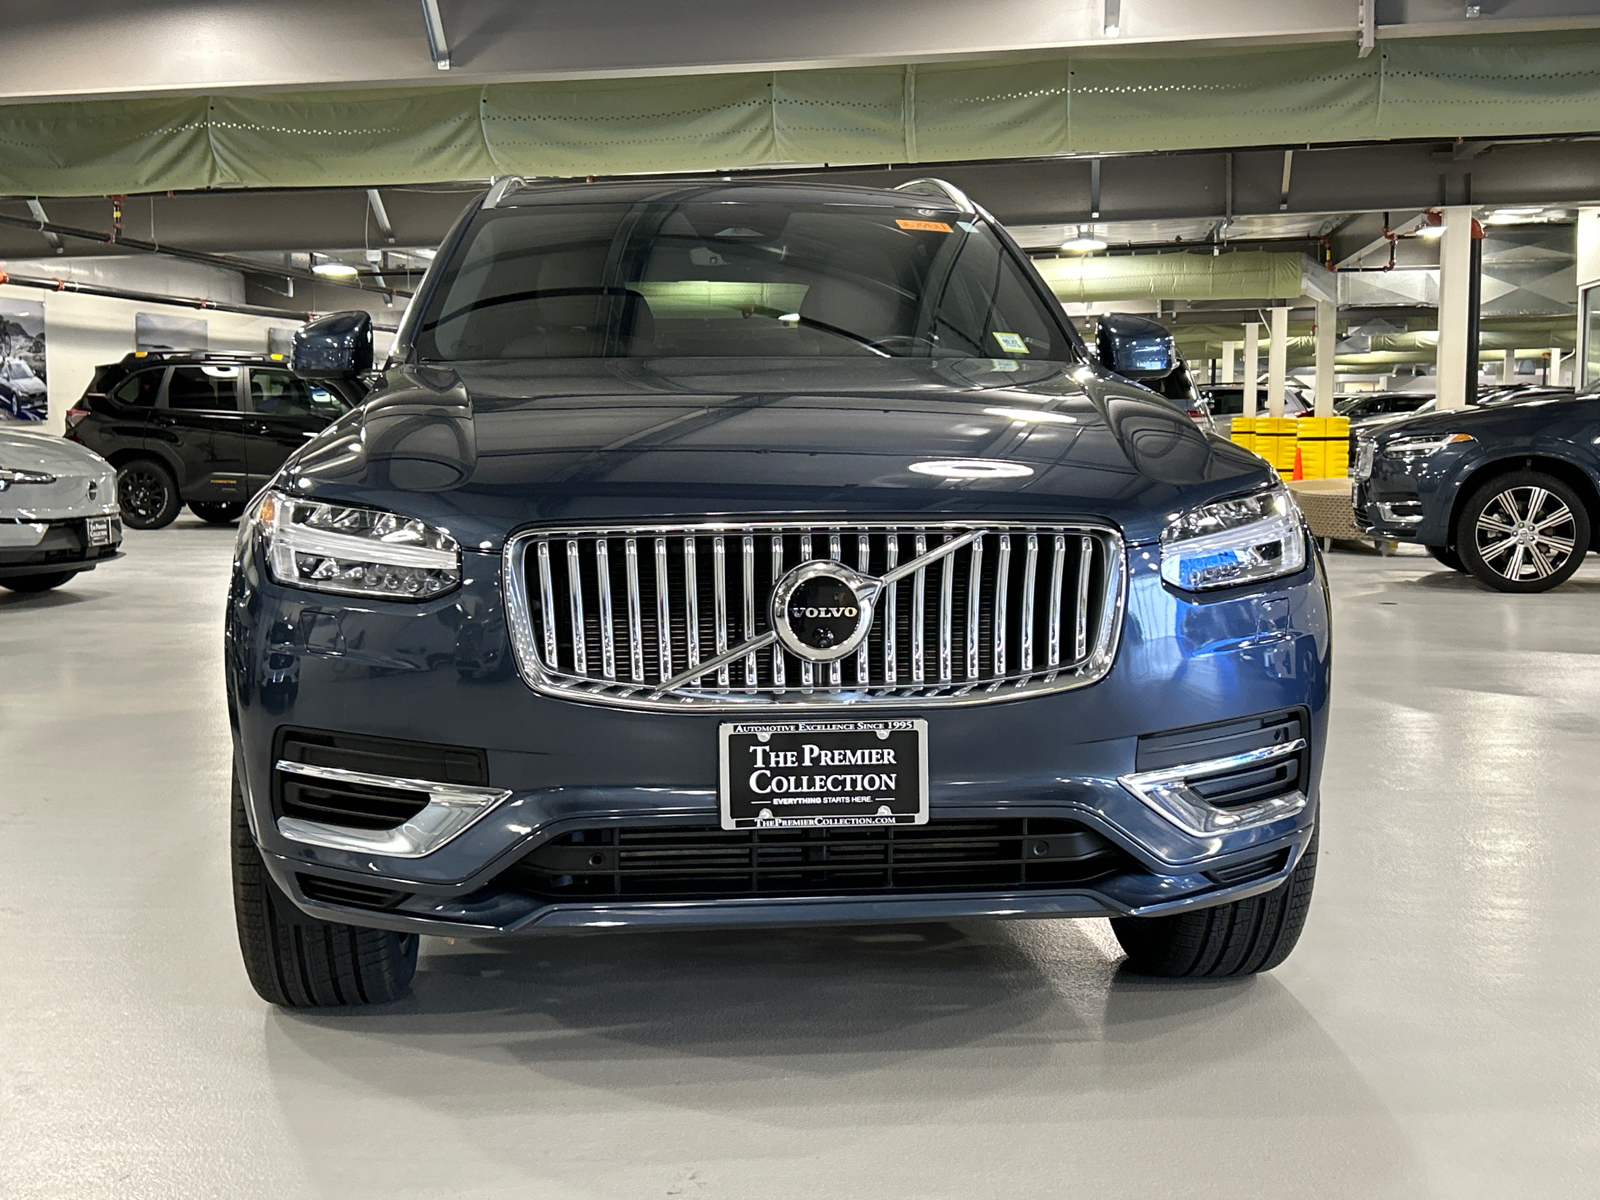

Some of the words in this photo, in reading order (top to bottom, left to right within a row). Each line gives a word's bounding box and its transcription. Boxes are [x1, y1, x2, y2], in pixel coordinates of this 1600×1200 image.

[791, 607, 858, 618] VOLVO
[735, 724, 796, 733] AUTOMOTIVE
[799, 722, 855, 732] EXCELLENCE
[857, 721, 885, 730] SINCE
[888, 721, 913, 730] 1995
[750, 745, 798, 768] THE
[802, 744, 897, 766] PREMIER
[750, 769, 897, 794] COLLECTION
